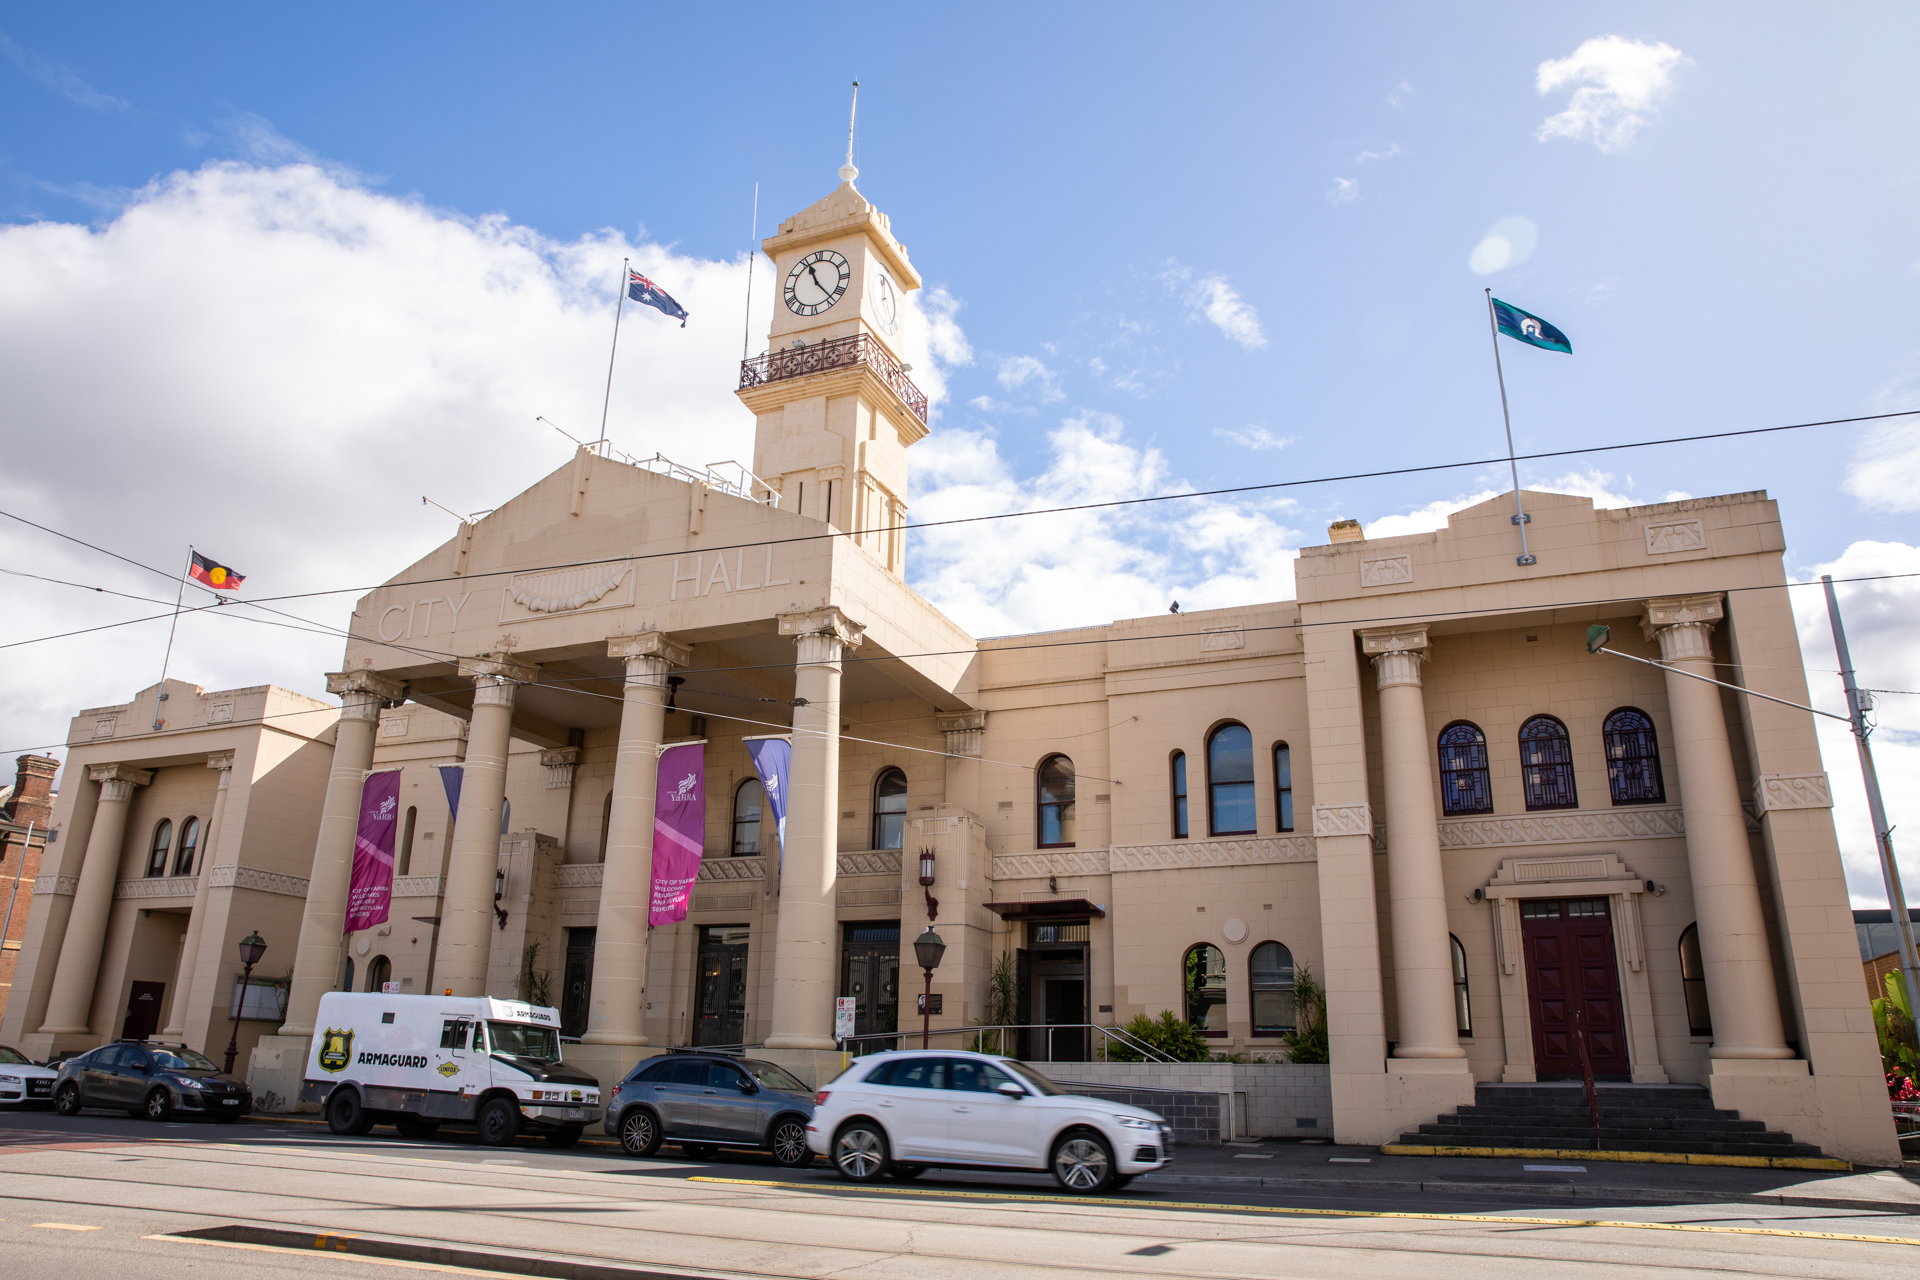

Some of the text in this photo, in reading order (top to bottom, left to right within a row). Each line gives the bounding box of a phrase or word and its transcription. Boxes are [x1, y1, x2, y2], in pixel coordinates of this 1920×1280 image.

[377, 543, 791, 642] CITY HALL
[517, 1010, 552, 1022] ARMAGUARD
[357, 1052, 428, 1069] ARMAGUARD
